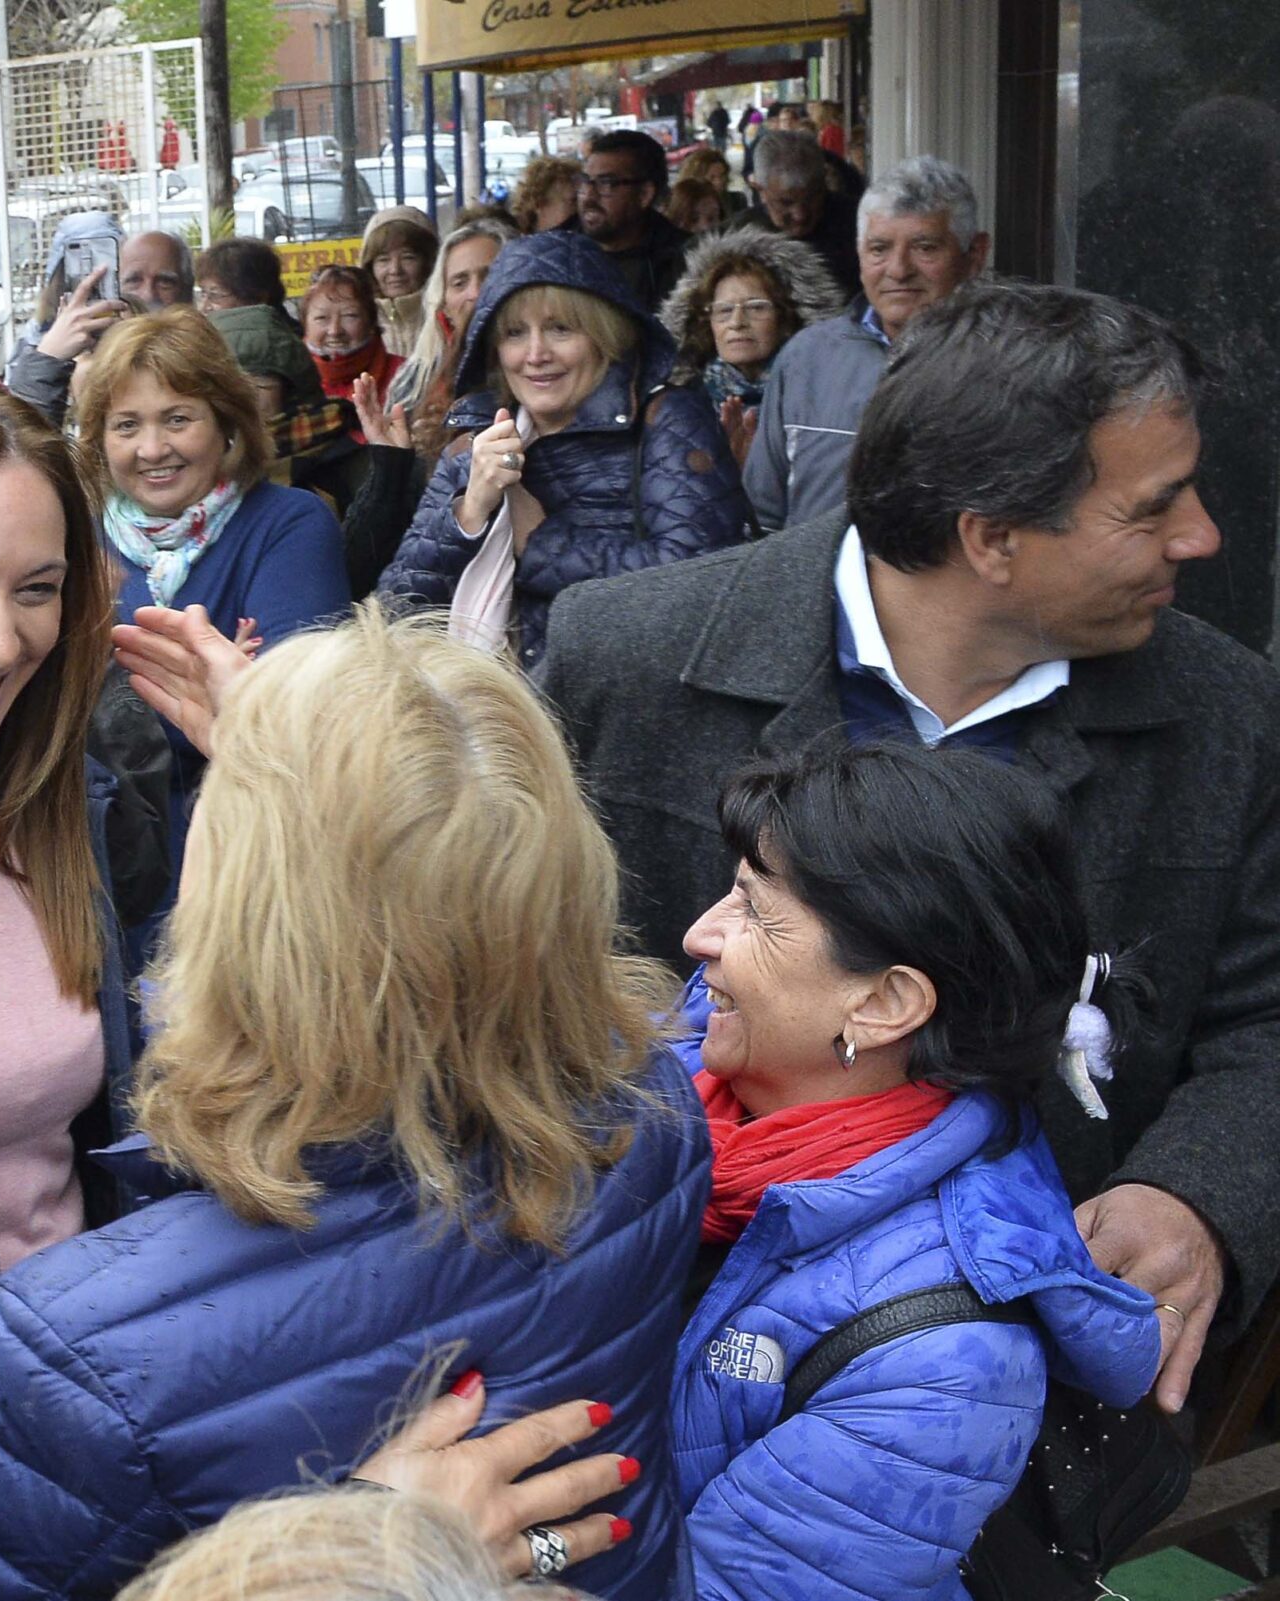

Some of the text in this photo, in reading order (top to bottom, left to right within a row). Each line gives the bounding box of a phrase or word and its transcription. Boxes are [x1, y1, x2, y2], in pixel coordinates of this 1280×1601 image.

[481, 0, 553, 32] Casa
[725, 1327, 755, 1351] THE
[708, 1339, 751, 1367] ORTH
[710, 1357, 750, 1379] FACE
